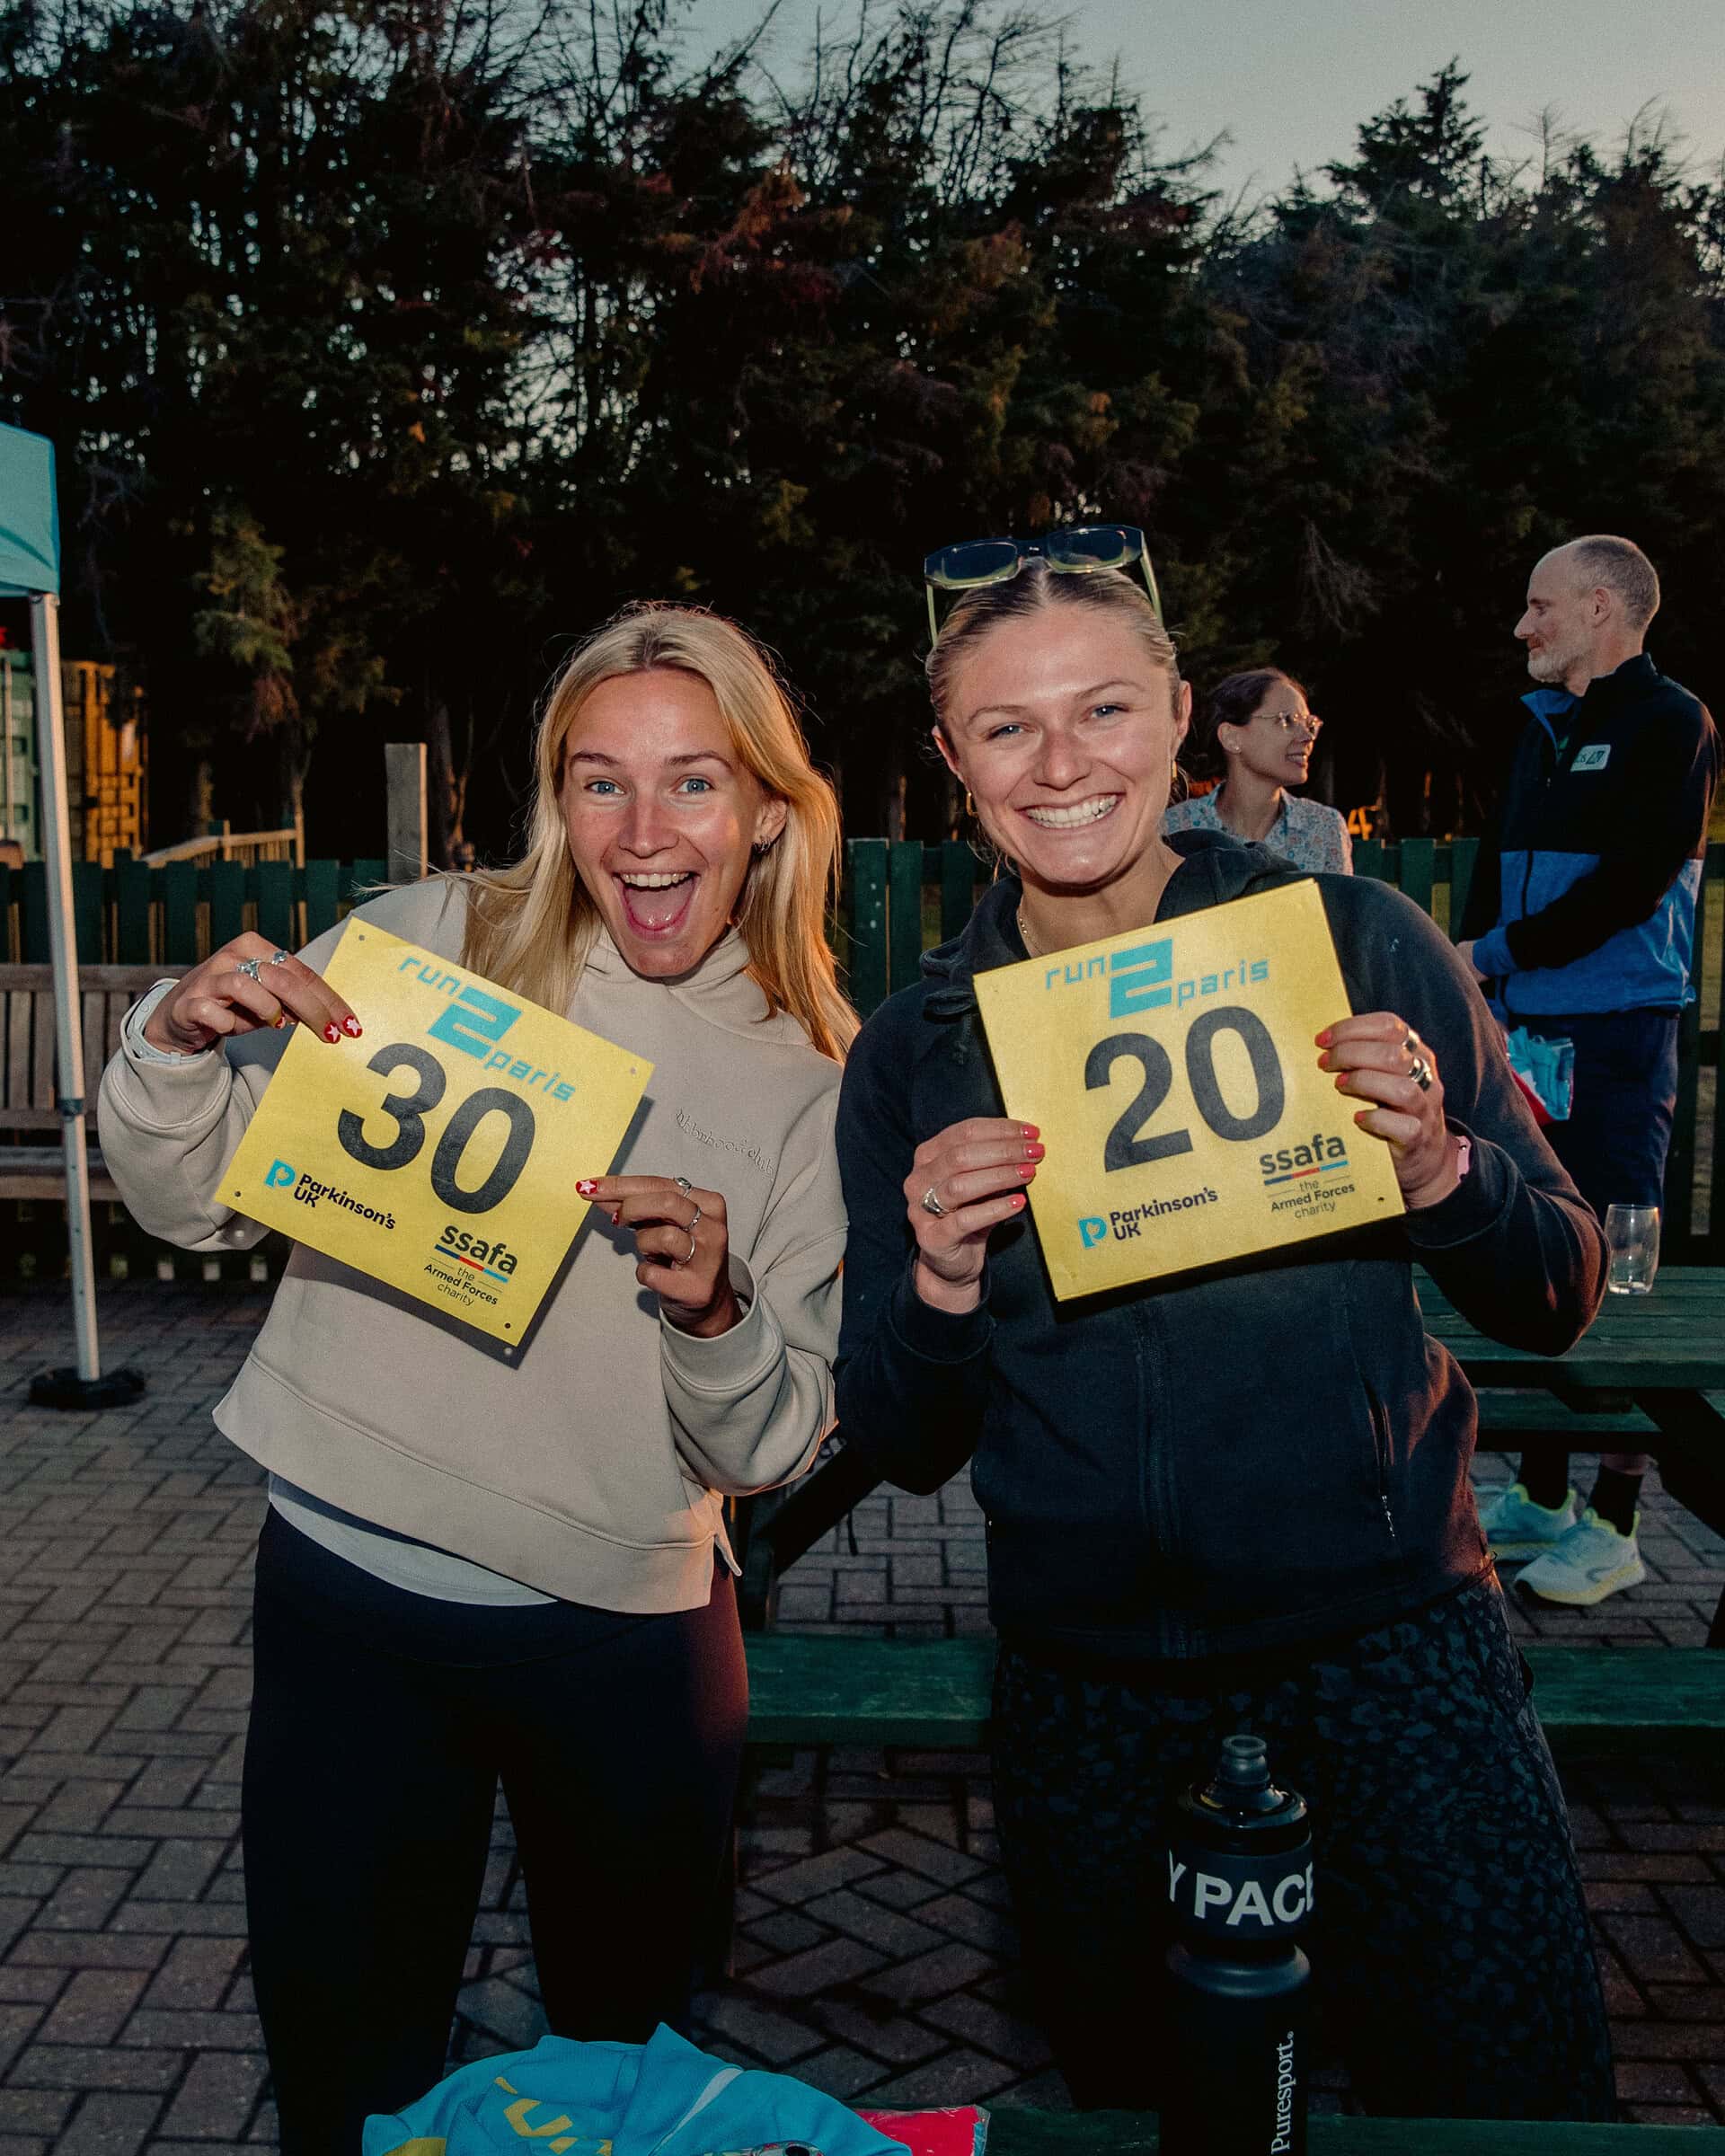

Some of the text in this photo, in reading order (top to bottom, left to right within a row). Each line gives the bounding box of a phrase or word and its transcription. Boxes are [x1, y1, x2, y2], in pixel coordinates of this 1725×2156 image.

[1084, 1006, 1285, 1173] 20
[337, 1043, 535, 1215] 30
[1260, 1134, 1346, 1175] ssafa
[294, 1186, 320, 1208] UK
[299, 1173, 396, 1230] Parkinson's
[1271, 1184, 1355, 1212] Armed Forces
[1299, 1180, 1319, 1192] the
[1109, 1187, 1218, 1226] Parkinson's
[1294, 1201, 1336, 1218] charity
[1113, 1223, 1141, 1241] UK
[439, 1225, 518, 1276] ssafa
[423, 1264, 498, 1305] Armed Forces
[456, 1268, 475, 1281] the
[437, 1283, 474, 1306] charity
